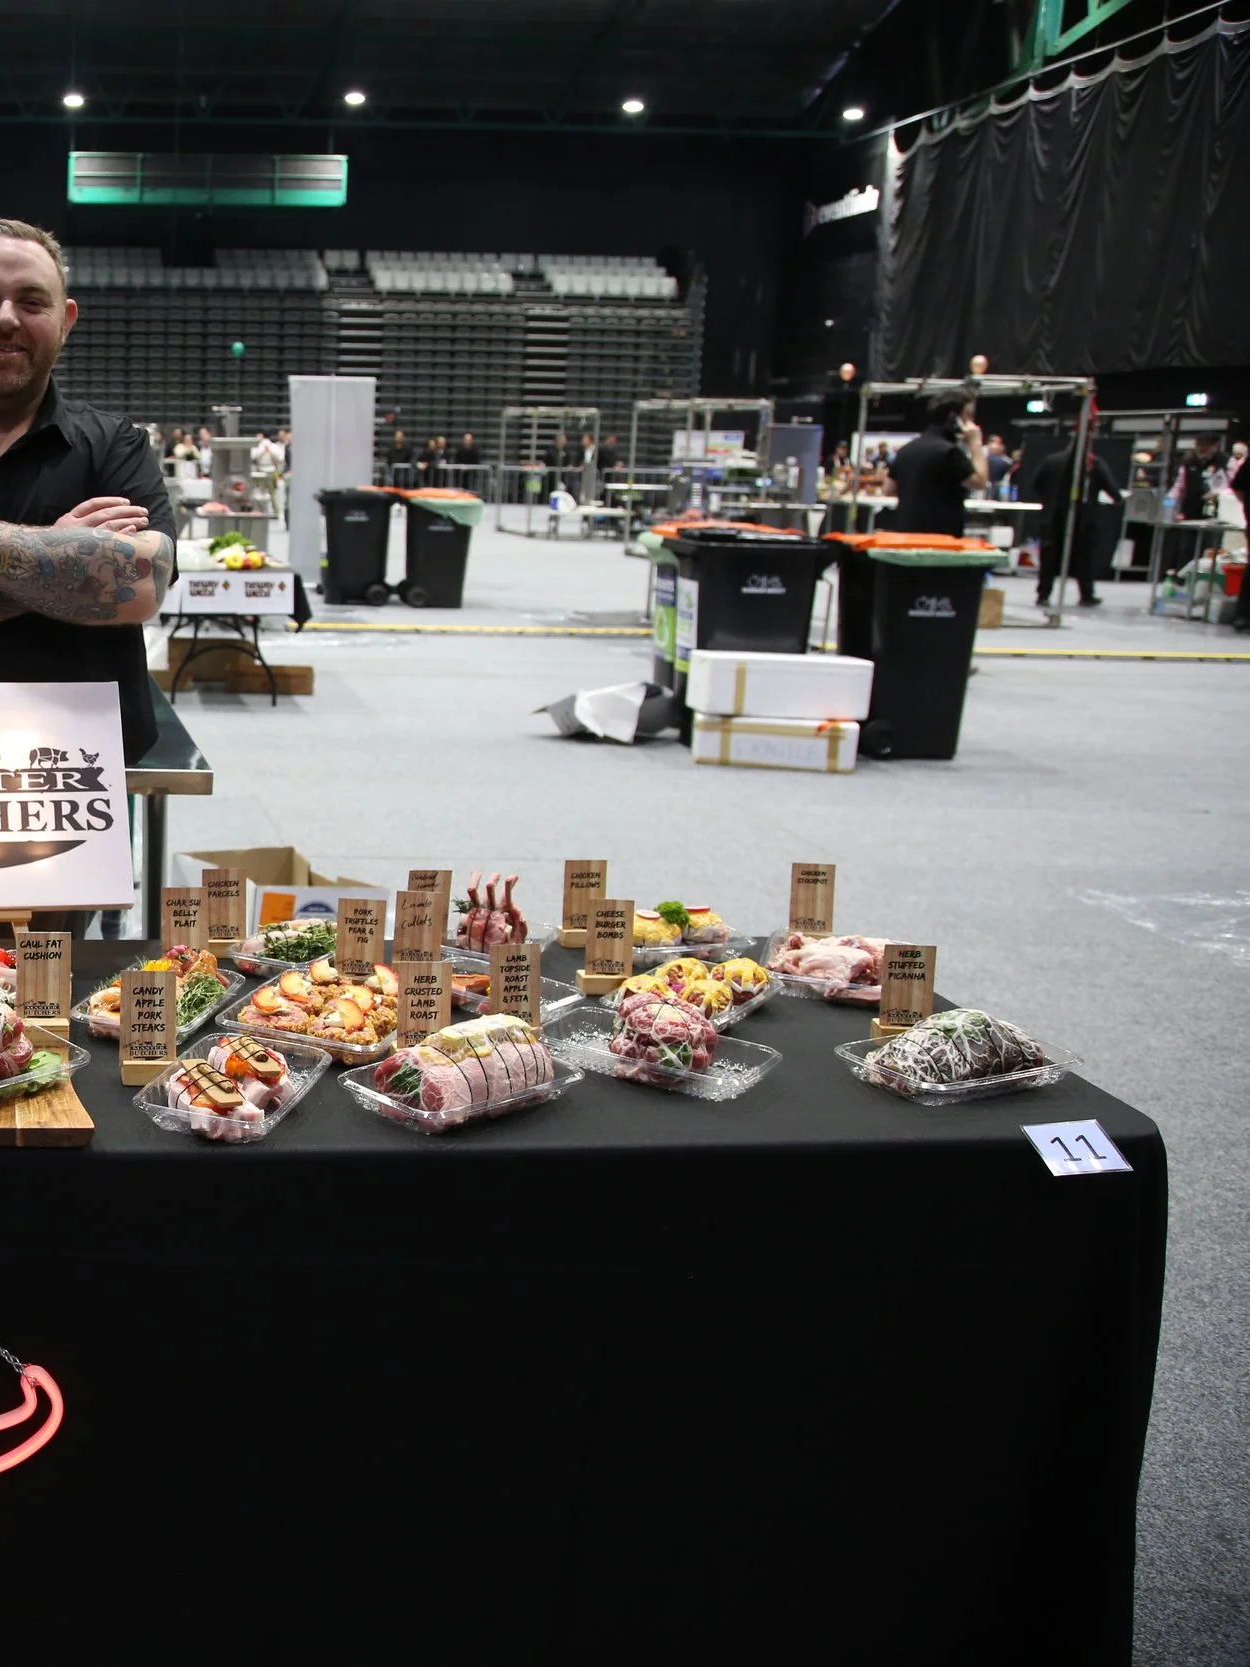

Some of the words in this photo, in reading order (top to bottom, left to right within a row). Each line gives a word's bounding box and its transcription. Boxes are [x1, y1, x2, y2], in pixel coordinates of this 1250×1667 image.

[571, 871, 601, 879] CHICKEN
[208, 880, 239, 888] CHICKEN
[570, 881, 601, 889] PILLOWS
[208, 890, 240, 898] PARCELS
[166, 899, 187, 907] CHAR
[173, 909, 198, 917] BELLY
[353, 908, 372, 916] PORK
[596, 910, 625, 918] CHEESE
[174, 919, 197, 928] PLAIT
[345, 917, 379, 926] TRUFFLES
[595, 920, 626, 929] BURGER
[348, 926, 366, 934] PEAR
[368, 926, 374, 934] &
[596, 931, 624, 939] BOMBS
[20, 940, 43, 949] CAUL
[46, 939, 63, 949] FAT
[357, 936, 369, 944] FIG
[23, 951, 62, 960] CUSHION
[506, 954, 527, 962] LAMB
[898, 950, 922, 958] HERB
[500, 964, 530, 973] TOPSIDE
[888, 961, 925, 970] STUFFED
[413, 975, 438, 984] HERB
[504, 974, 529, 983] ROAST
[888, 972, 926, 981] PICANHA
[133, 986, 164, 995] CANDY
[404, 987, 443, 996] CRUSTED
[503, 985, 527, 993] APPLE
[411, 999, 436, 1007] LAMB
[502, 995, 508, 1003] &
[510, 994, 528, 1003] FETA
[135, 999, 165, 1008] APPLE
[137, 1011, 162, 1020] PORK
[410, 1010, 439, 1020] ROAST
[131, 1023, 166, 1032] STEAKS
[1050, 1134, 1107, 1161] 11
